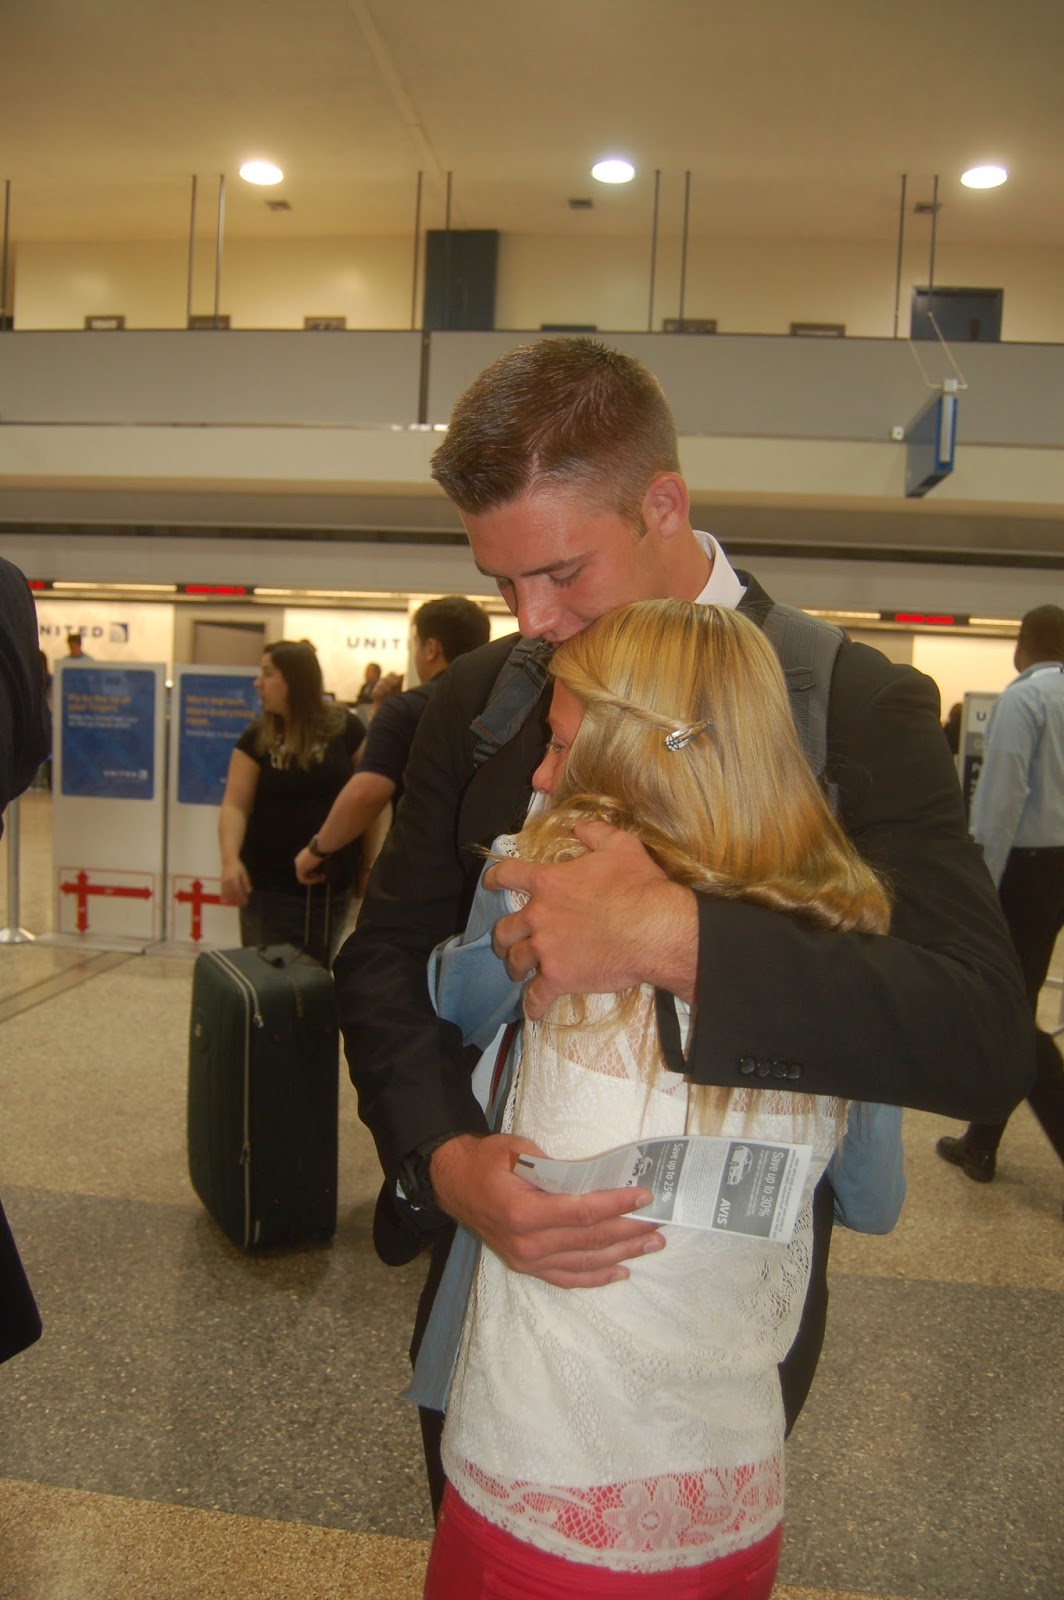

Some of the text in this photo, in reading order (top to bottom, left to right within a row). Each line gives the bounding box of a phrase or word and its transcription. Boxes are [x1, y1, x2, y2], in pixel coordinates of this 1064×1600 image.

[39, 624, 103, 638] NITED
[346, 637, 401, 649] UNIT
[671, 1143, 684, 1162] Save
[670, 1162, 677, 1173] up
[665, 1172, 674, 1182] to
[758, 1152, 784, 1217] Save up to 30%
[661, 1182, 674, 1202] 25%
[717, 1198, 731, 1225] AVIS
